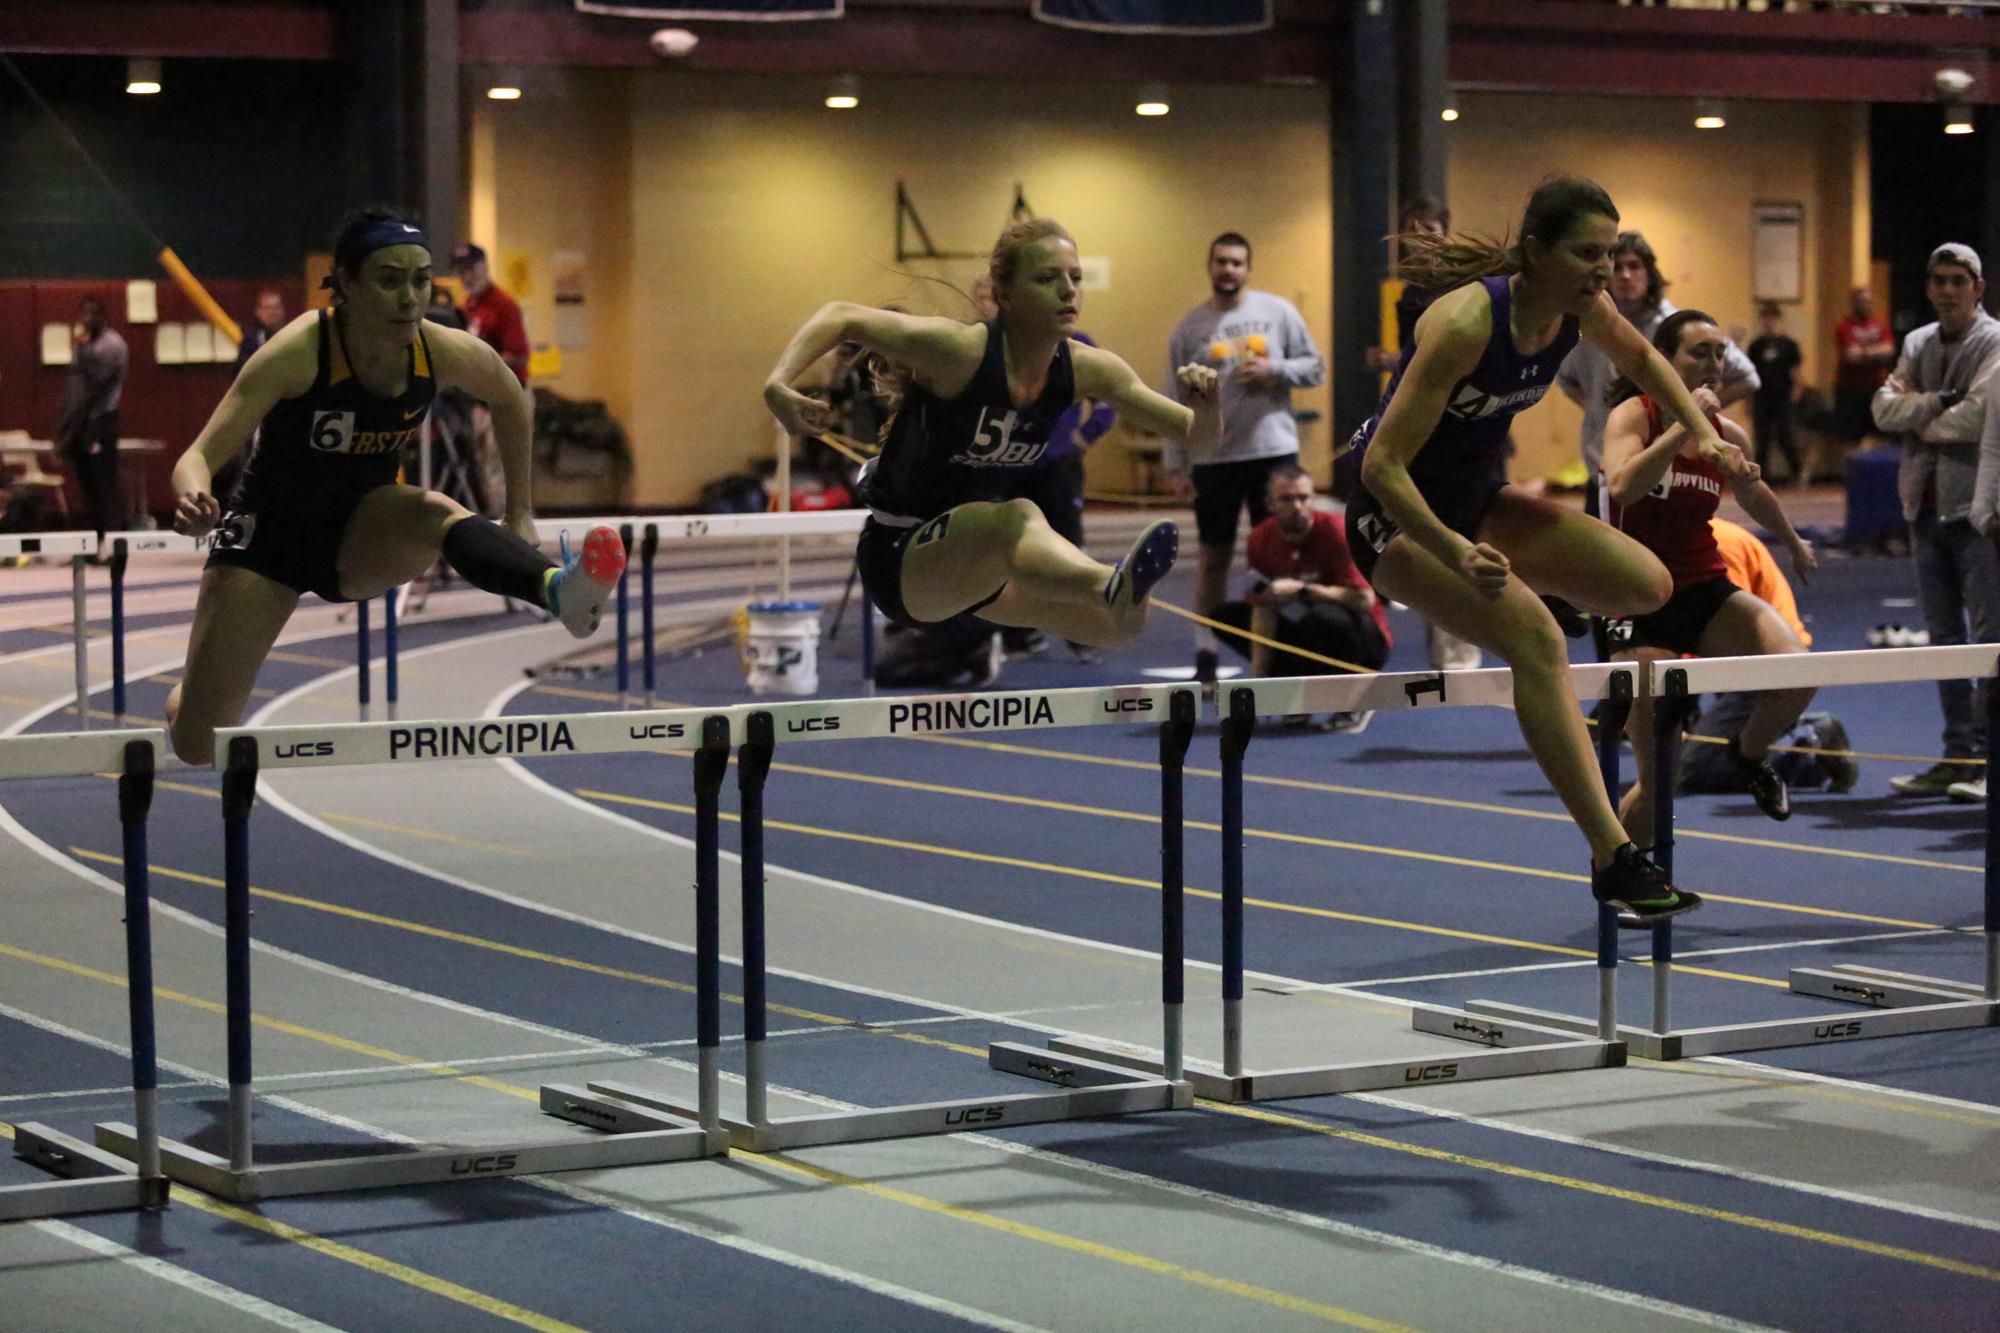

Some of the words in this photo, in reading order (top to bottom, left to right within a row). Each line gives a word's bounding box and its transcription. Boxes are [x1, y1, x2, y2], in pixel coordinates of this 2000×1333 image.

[312, 412, 343, 450] 6
[967, 405, 1008, 455] 5
[787, 716, 841, 733] UCS
[889, 696, 1055, 733] PRINCIPIA
[1104, 697, 1154, 713] UCS
[275, 741, 335, 759] UCS
[390, 721, 575, 760] PRINCIPIA
[630, 723, 685, 740] UCS
[1814, 1021, 1863, 1039] UCS
[1405, 1063, 1458, 1081] UCS
[945, 1105, 1006, 1124] UCS
[450, 1154, 518, 1175] UCS
